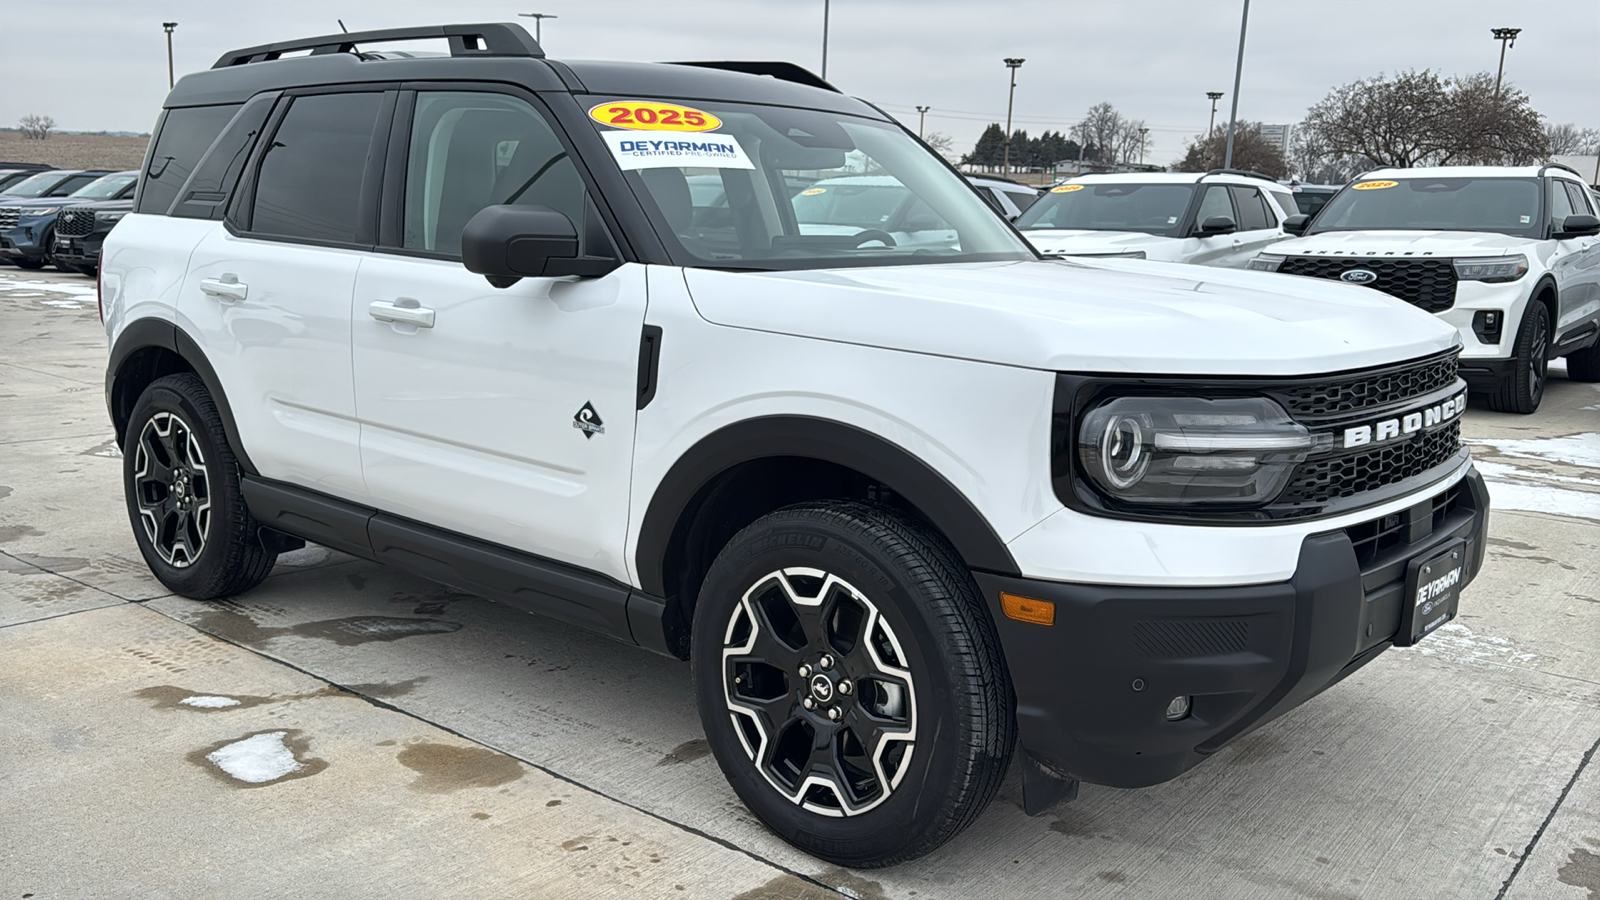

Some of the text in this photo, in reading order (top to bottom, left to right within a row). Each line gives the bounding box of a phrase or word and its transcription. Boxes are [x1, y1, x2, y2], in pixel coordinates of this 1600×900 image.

[608, 107, 707, 127] 2025
[620, 140, 735, 154] DEYARMAN
[685, 151, 737, 159] PRE-OWNED
[1343, 393, 1465, 449] BRONCO
[751, 533, 823, 555] MICHELIN
[1416, 566, 1461, 608] DEYARMAN
